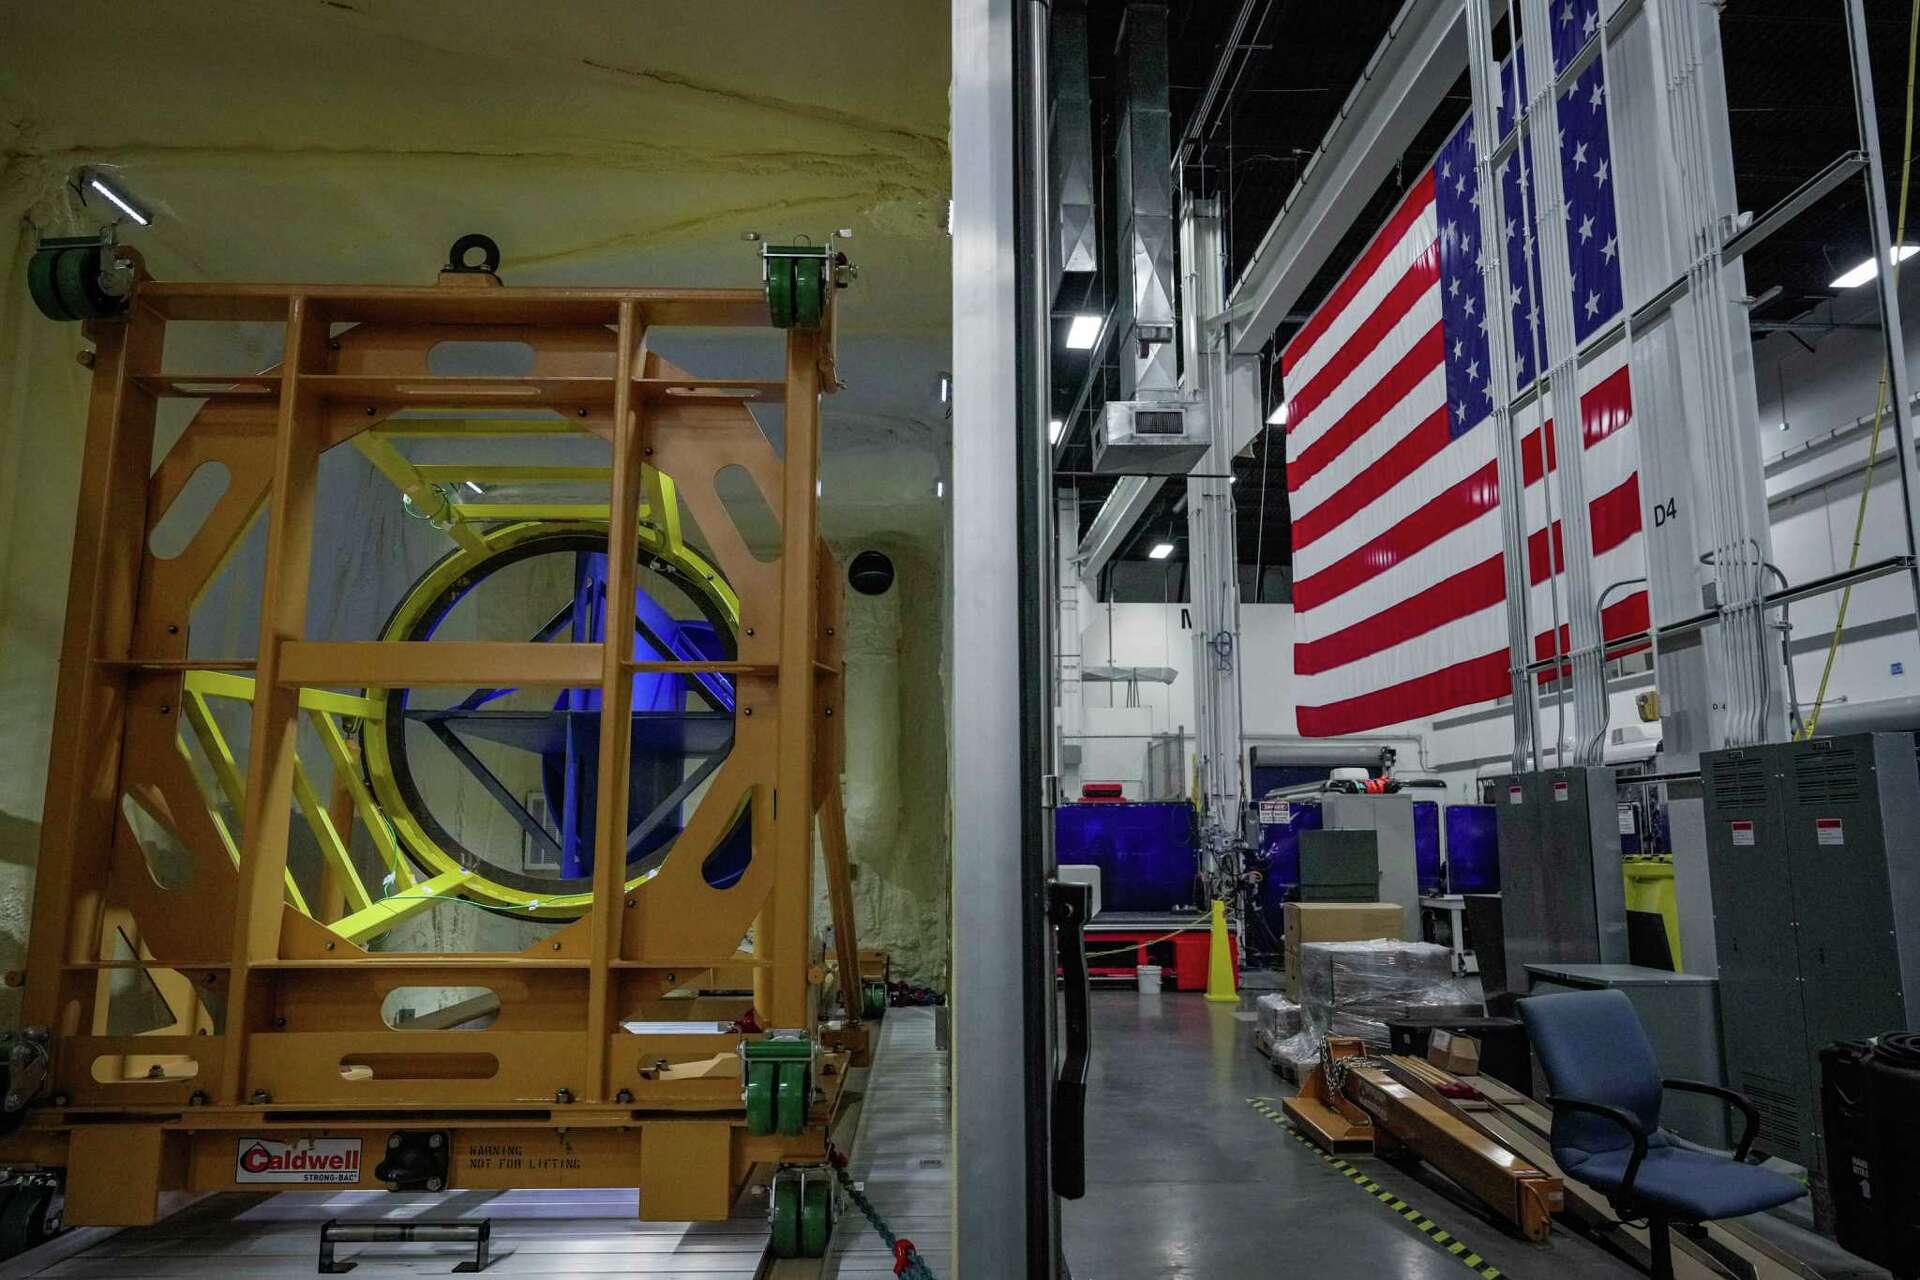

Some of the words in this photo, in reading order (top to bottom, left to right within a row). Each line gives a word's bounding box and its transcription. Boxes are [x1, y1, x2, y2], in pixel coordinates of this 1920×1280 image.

[1654, 496, 1677, 527] D4
[469, 1145, 522, 1156] WARNING
[245, 1149, 359, 1172] Caldwell
[470, 1158, 492, 1169] NOT
[499, 1158, 521, 1169] FOR
[529, 1158, 580, 1169] LIFTING
